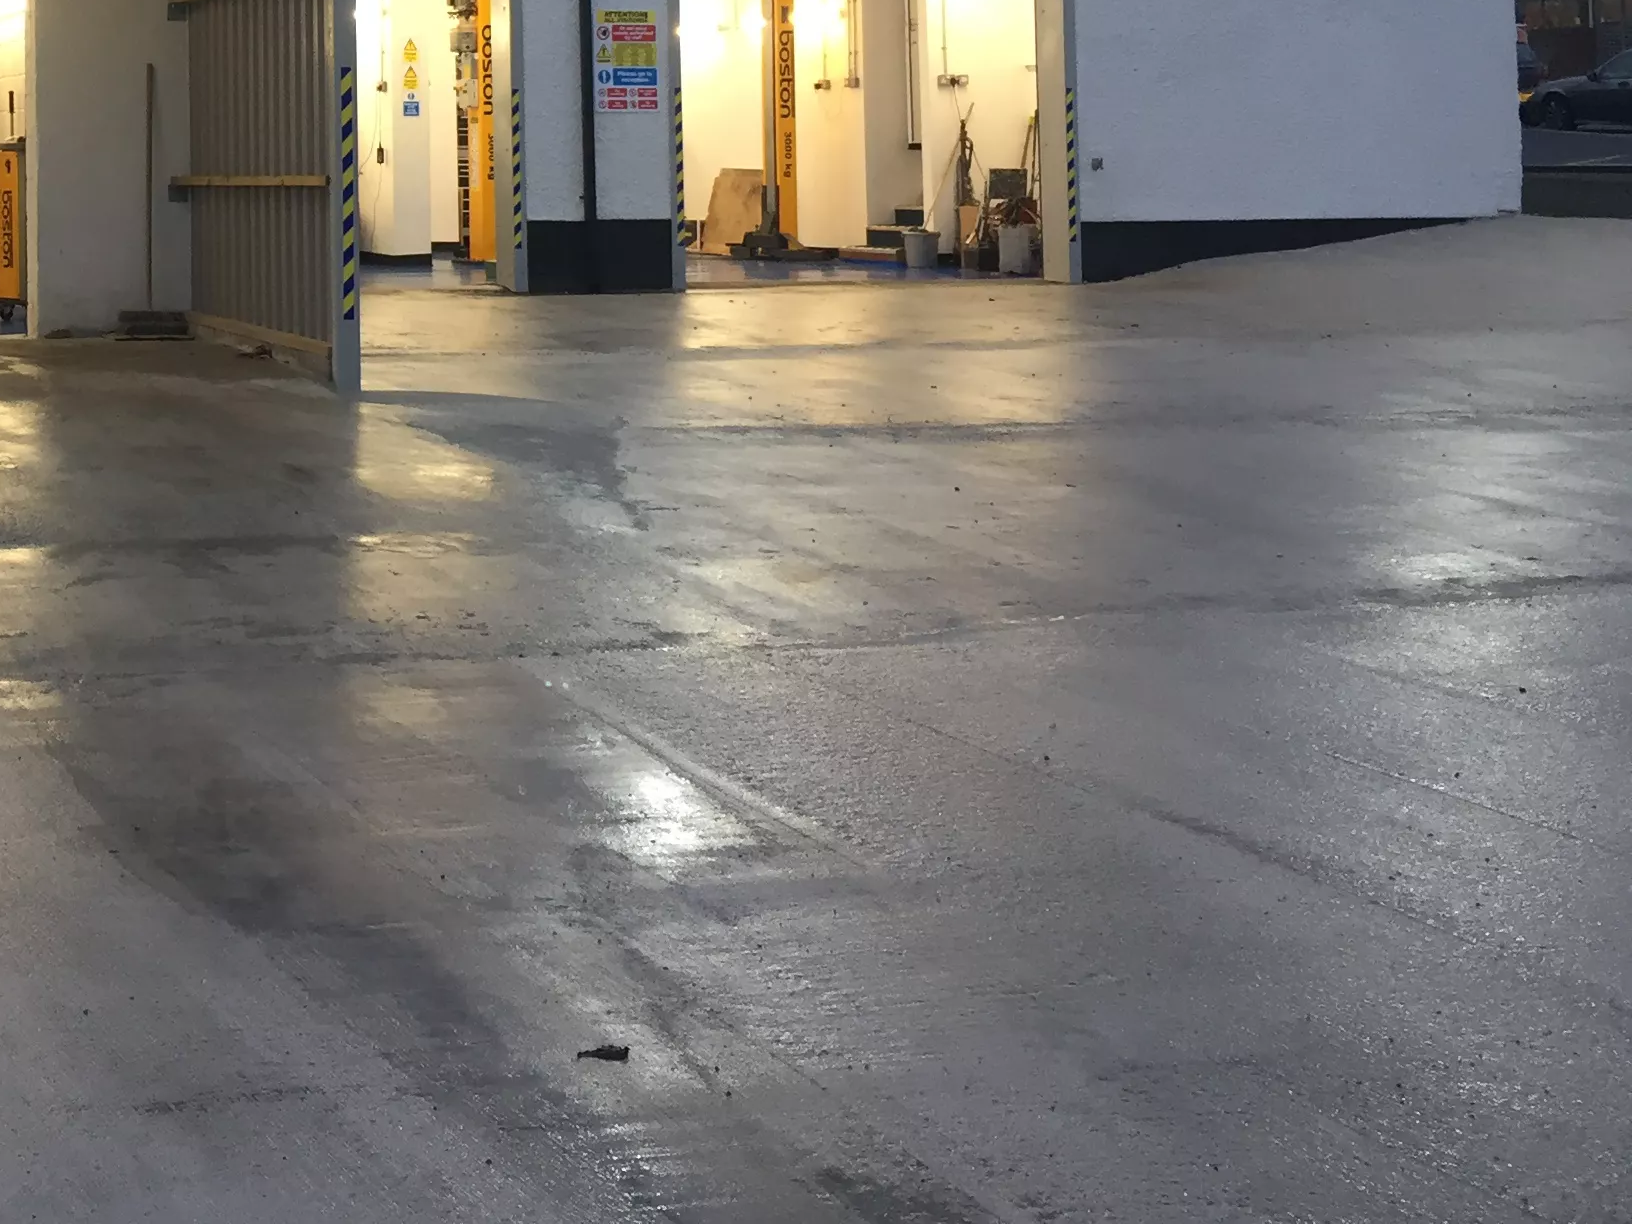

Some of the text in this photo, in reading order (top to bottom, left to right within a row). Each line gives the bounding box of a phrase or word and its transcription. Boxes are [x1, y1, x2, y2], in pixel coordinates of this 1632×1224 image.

[779, 29, 794, 119] boston
[783, 131, 793, 178] 3000 kg
[1, 190, 13, 268] boston
